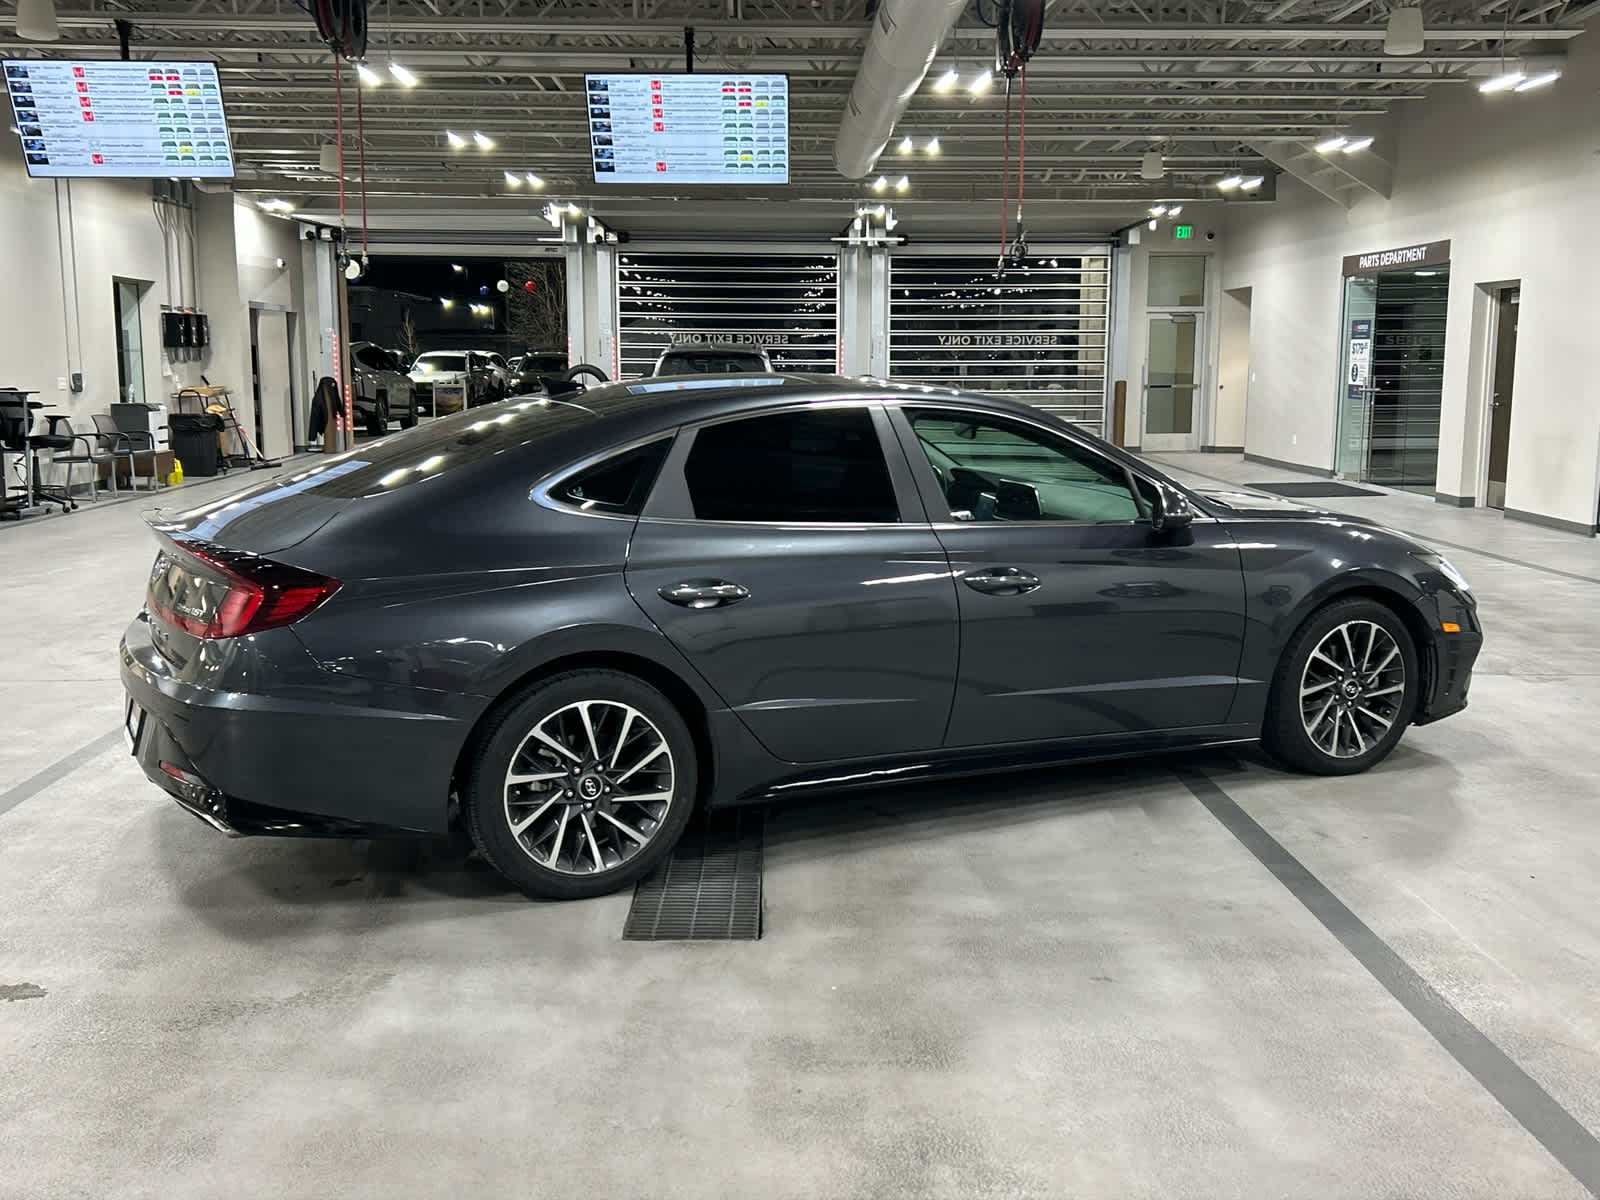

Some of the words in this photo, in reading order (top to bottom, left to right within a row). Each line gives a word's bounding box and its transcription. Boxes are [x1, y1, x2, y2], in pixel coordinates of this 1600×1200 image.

[1176, 225, 1192, 239] EXIT
[1359, 253, 1380, 269] PARTS
[1380, 246, 1427, 266] DEPARTMENT
